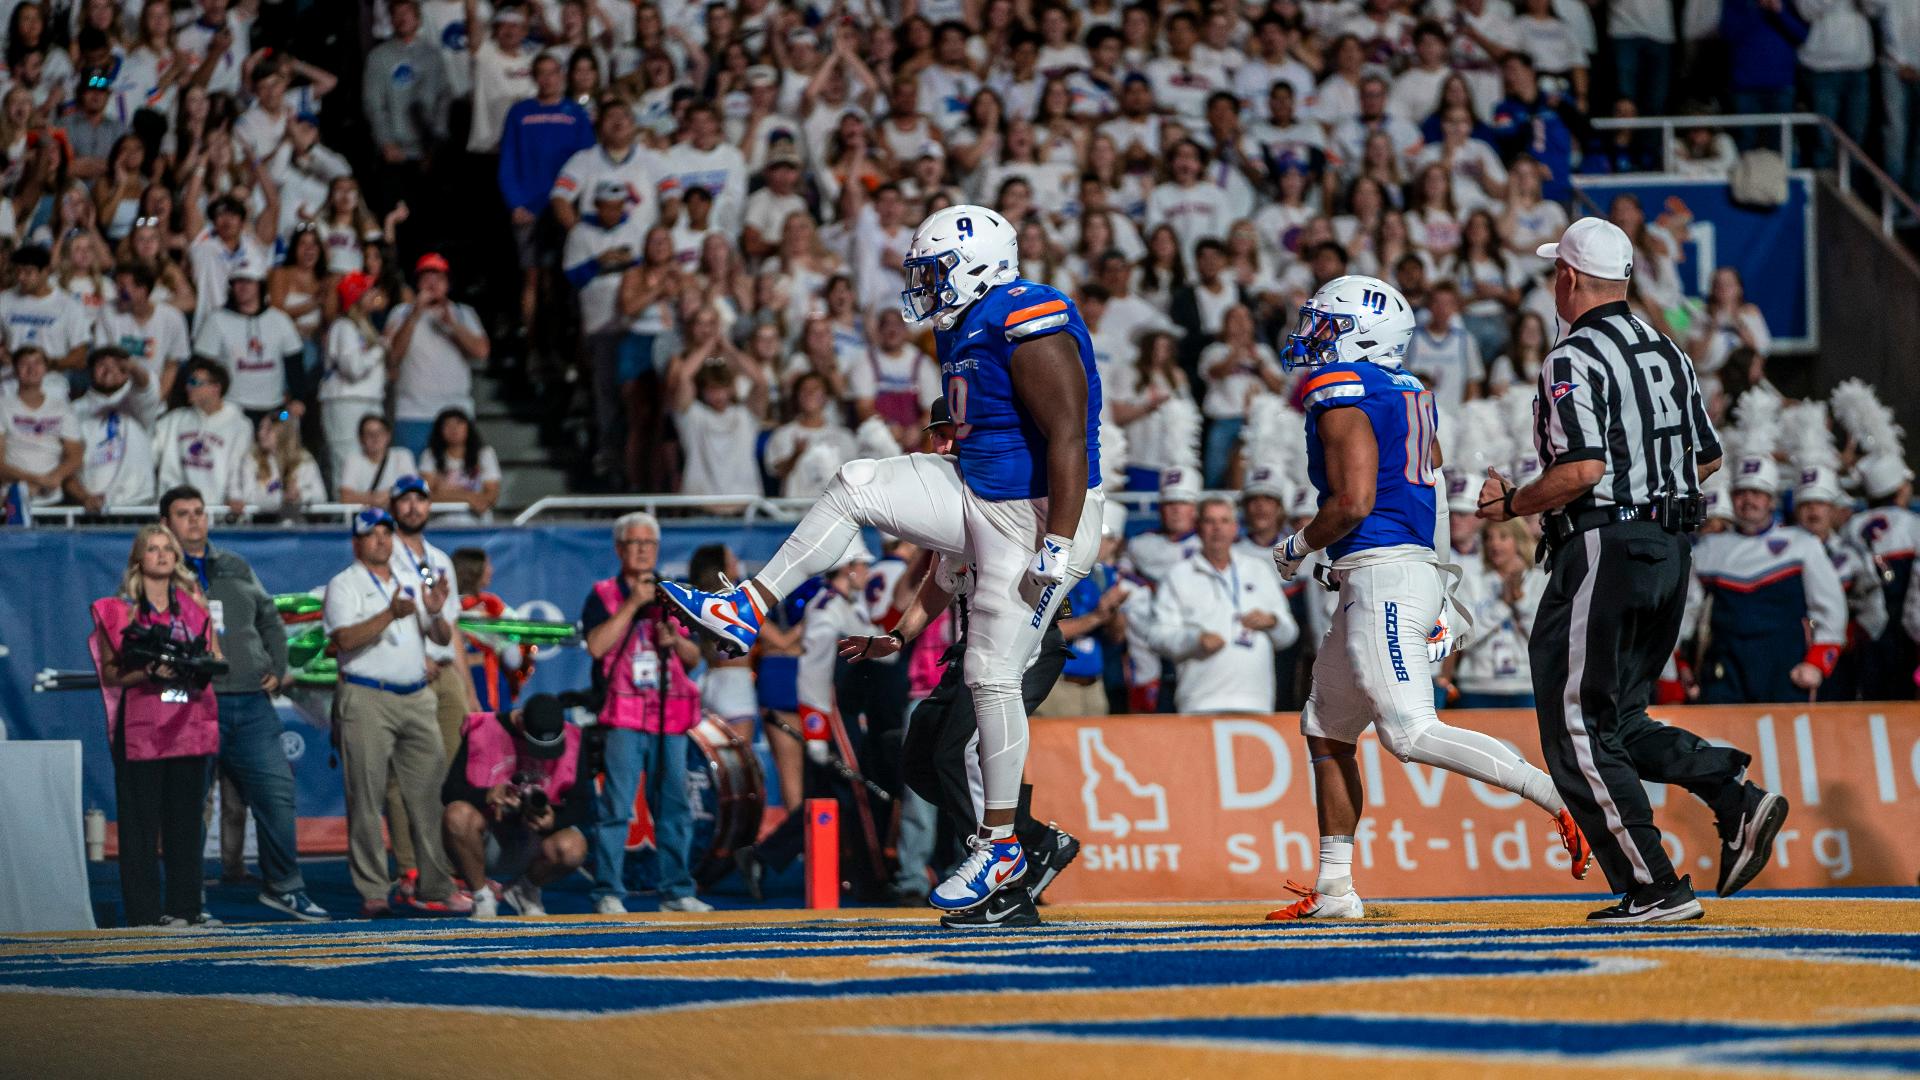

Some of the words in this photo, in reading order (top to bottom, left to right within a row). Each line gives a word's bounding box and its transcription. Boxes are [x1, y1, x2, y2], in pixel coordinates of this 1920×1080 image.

[956, 217, 974, 241] 9
[1362, 289, 1387, 315] 10
[1635, 351, 1682, 431] R
[1402, 390, 1437, 487] 10
[1030, 580, 1058, 630] BRON
[1384, 600, 1410, 683] BRONCOS
[1083, 843, 1182, 872] SHIFT
